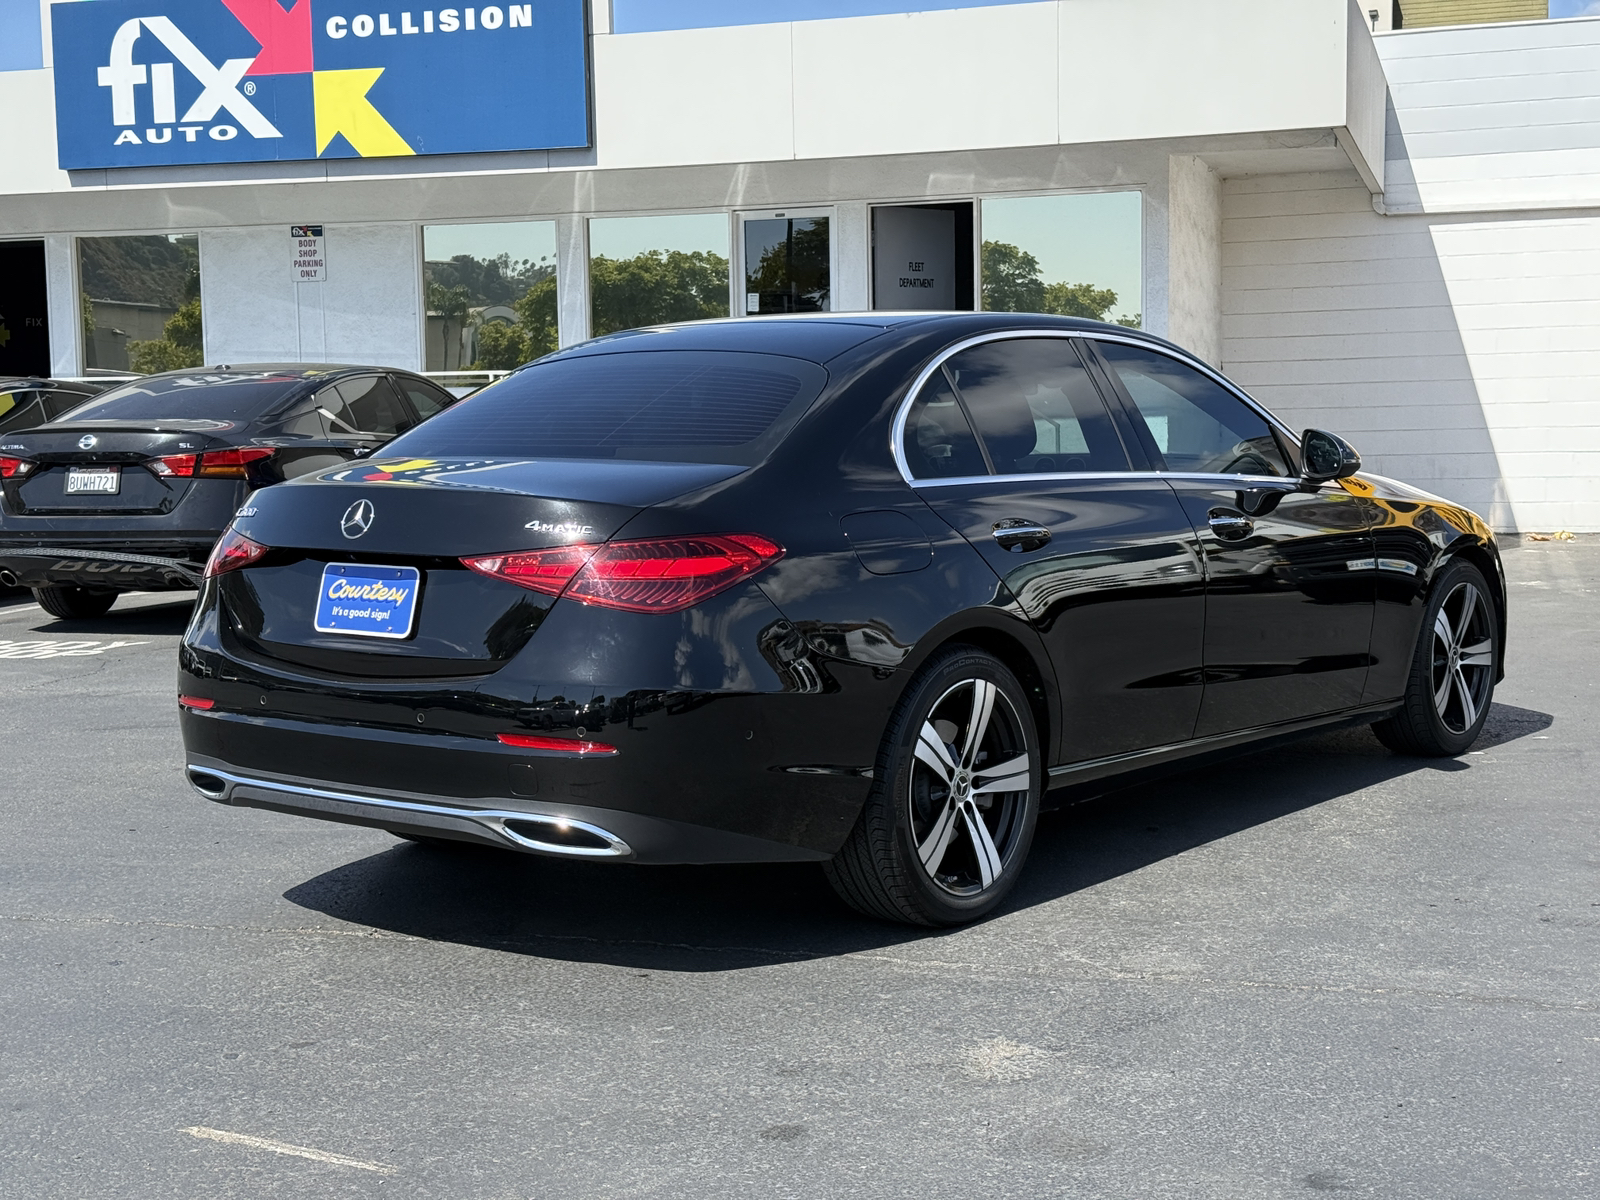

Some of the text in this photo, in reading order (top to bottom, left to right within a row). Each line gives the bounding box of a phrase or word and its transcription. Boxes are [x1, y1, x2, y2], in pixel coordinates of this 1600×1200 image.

[325, 4, 533, 39] COLLISION
[97, 16, 284, 139] fix
[113, 125, 238, 145] AUTO
[298, 239, 317, 248] BODY
[298, 249, 318, 258] SHOP
[293, 259, 324, 268] PARKING
[908, 261, 925, 272] FLEET
[300, 269, 318, 278] ONLY
[898, 277, 935, 288] DEPARTMENT
[25, 317, 43, 327] FIX
[69, 476, 115, 490] 8UWH721
[524, 520, 593, 535] 4MATIC
[327, 578, 409, 607] Courtesy
[332, 605, 391, 622] It's a good sign!
